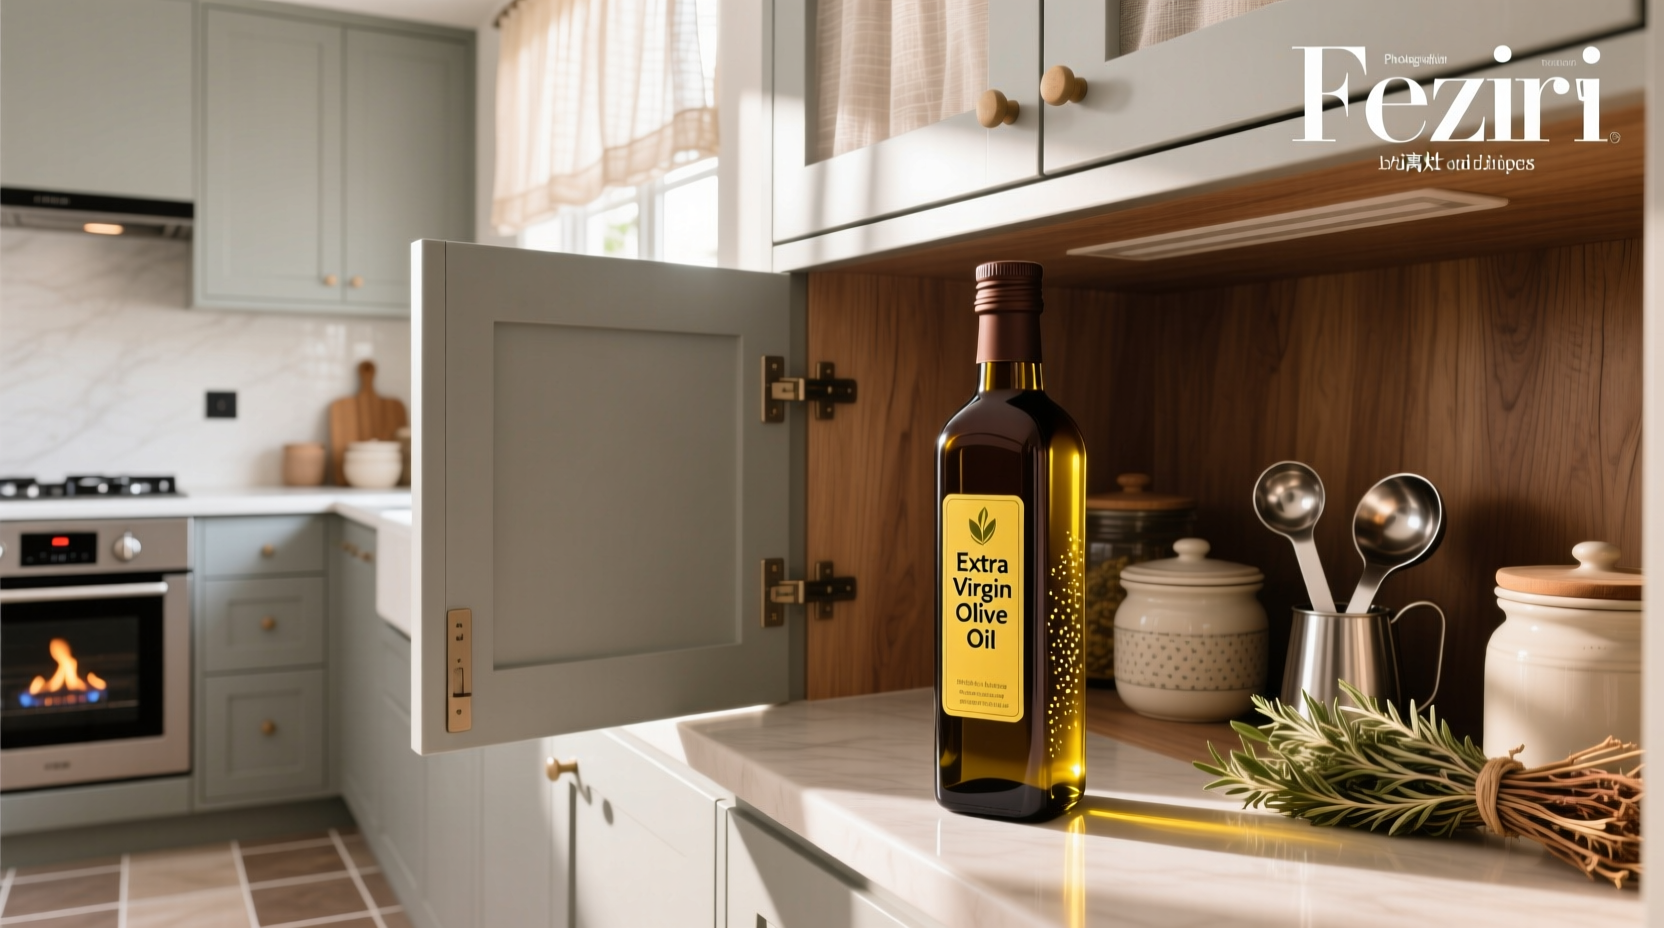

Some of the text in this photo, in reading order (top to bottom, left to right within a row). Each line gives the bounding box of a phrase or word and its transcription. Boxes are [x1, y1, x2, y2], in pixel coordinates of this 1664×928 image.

[957, 552, 1008, 574] Extra
[953, 577, 1012, 603] Virgin
[955, 603, 1008, 625] Olive
[966, 628, 996, 650] Oil
